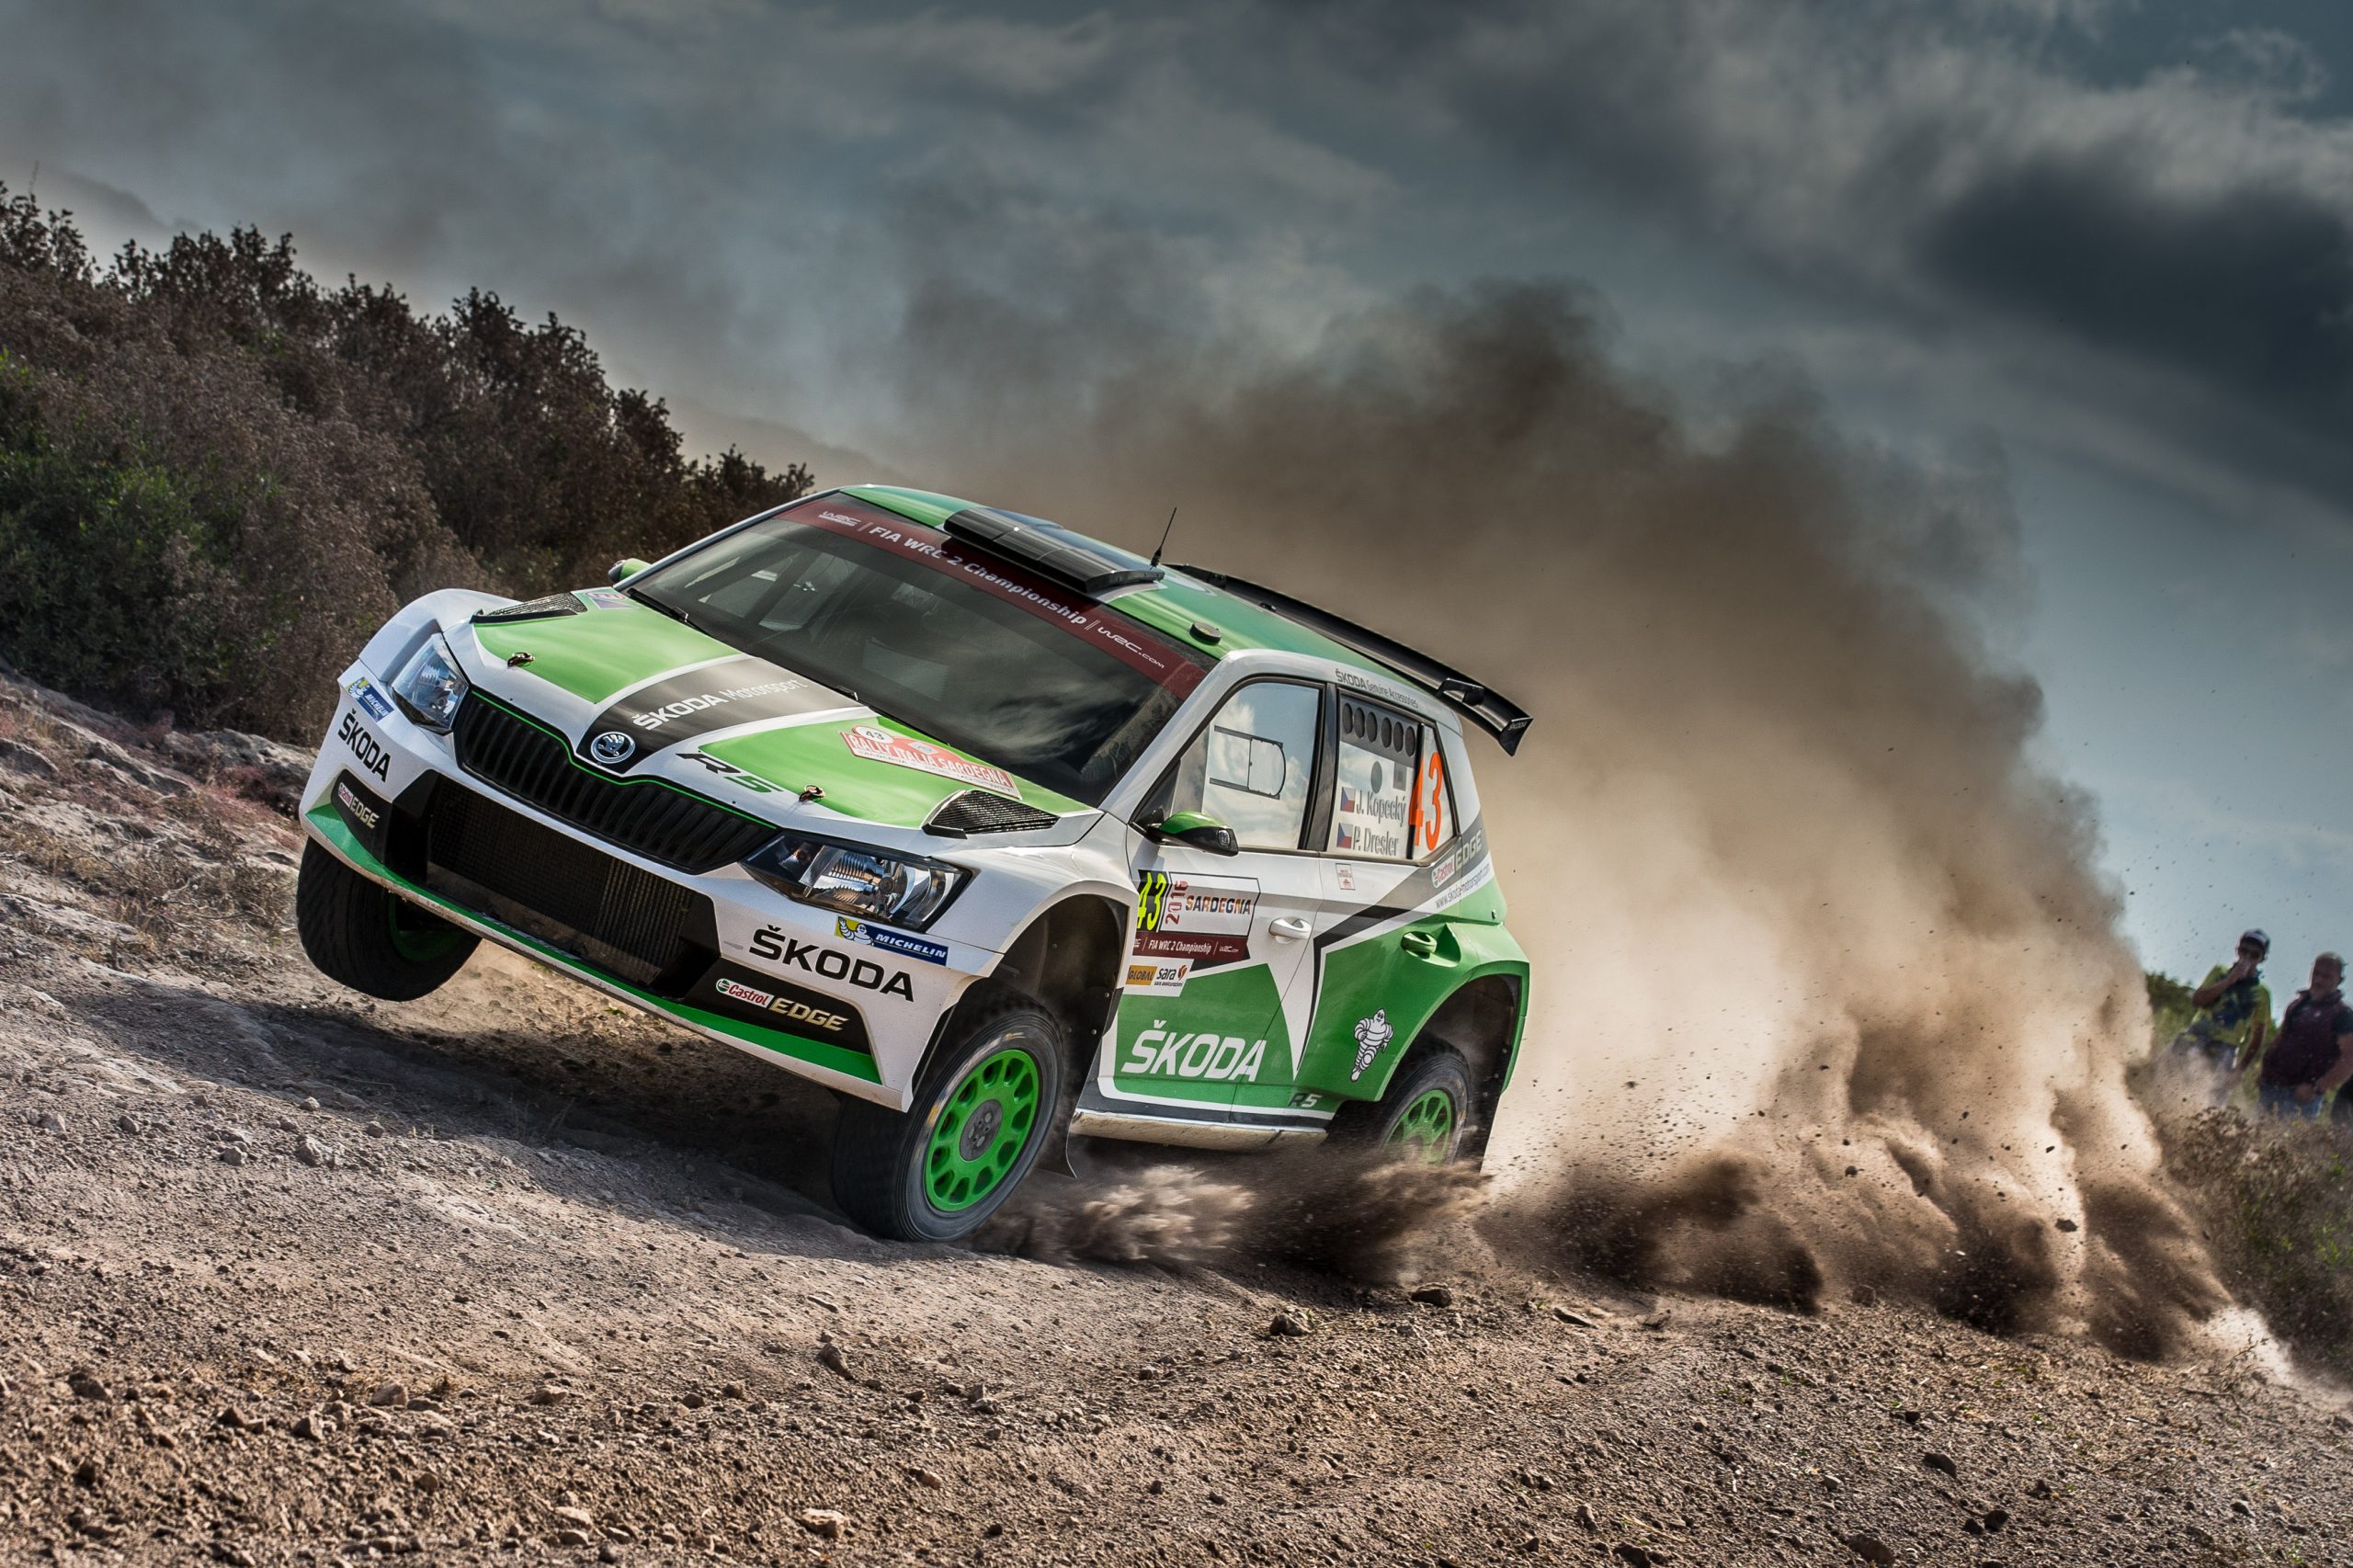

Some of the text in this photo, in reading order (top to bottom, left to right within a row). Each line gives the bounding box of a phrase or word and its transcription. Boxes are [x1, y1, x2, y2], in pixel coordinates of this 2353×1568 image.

[869, 527, 1087, 625] FIA WRC 2 Championship
[632, 678, 809, 731] ŠKODA Motorsport
[1336, 668, 1367, 689] ŠKODA
[1389, 687, 1419, 709] Accessories
[337, 708, 391, 782] ŠKODA
[864, 731, 885, 742] 43
[676, 753, 785, 793] R5
[850, 734, 895, 756] RALLY
[894, 746, 938, 768] ITALIA
[938, 757, 1011, 788] SARDEGNA
[350, 796, 380, 829] EDGE
[1356, 791, 1407, 827] J. Kopecký
[1409, 752, 1443, 851] 43
[1353, 826, 1400, 857] P. Dresler
[1455, 829, 1483, 871] EDGE
[1137, 872, 1166, 930] 43
[1185, 895, 1252, 915] SARDEGNA
[749, 924, 915, 1002] ŠKODA
[875, 933, 948, 959] MICHELIN
[1148, 939, 1212, 955] FIA WRC 2 Championship
[1128, 969, 1154, 981] GLOBAL
[1156, 968, 1176, 981] sara
[728, 983, 849, 1031] Castrol EDGE
[1120, 1019, 1267, 1083] ŠKODA
[1288, 1092, 1324, 1108] R5
